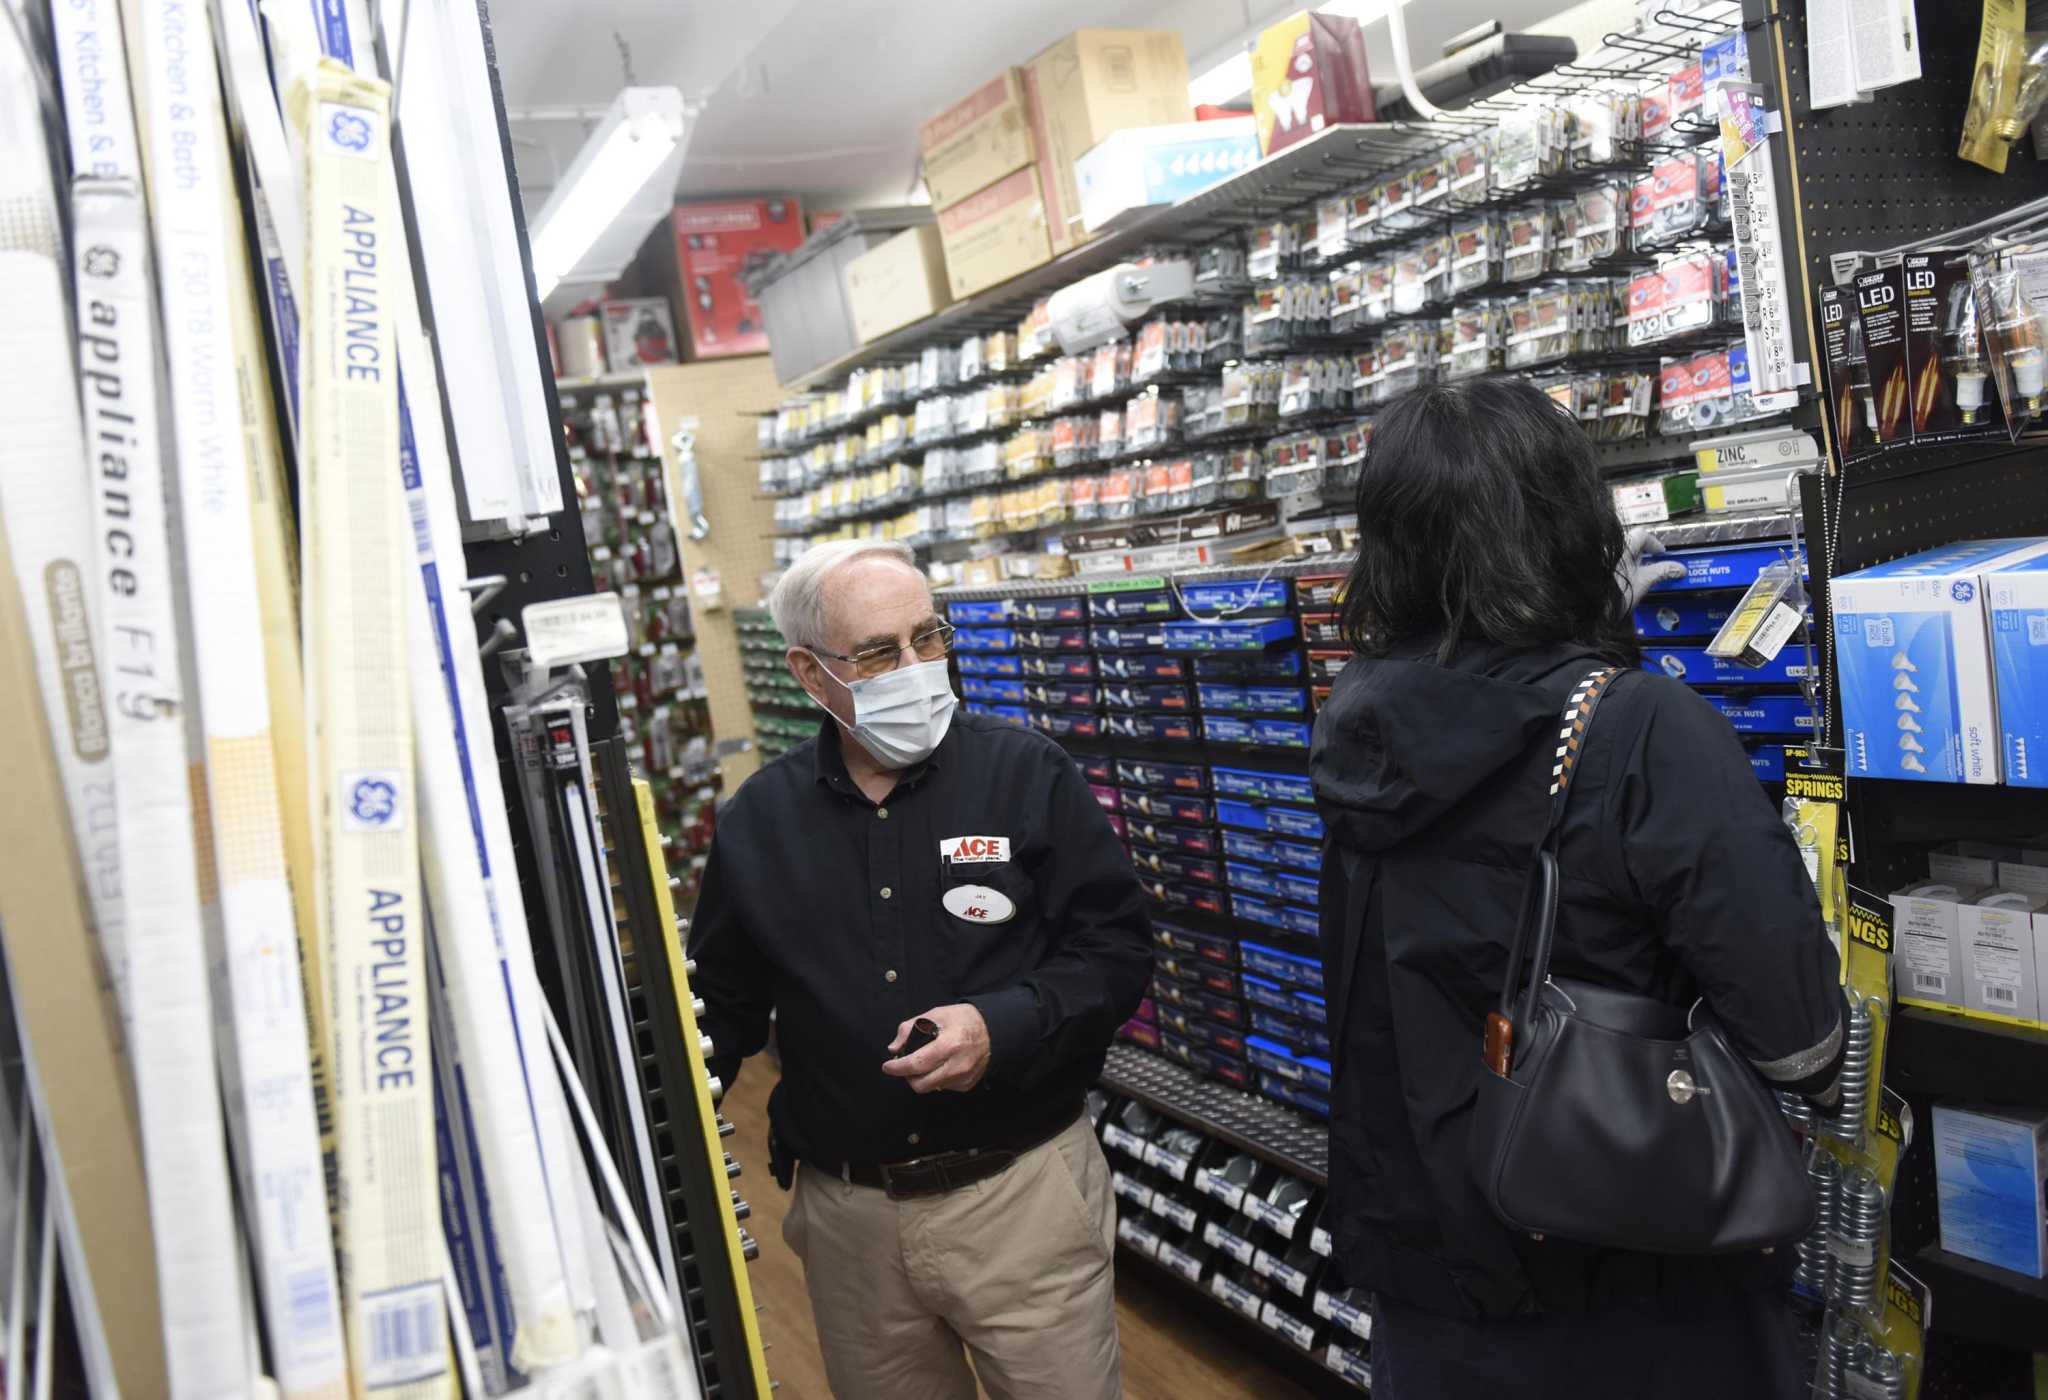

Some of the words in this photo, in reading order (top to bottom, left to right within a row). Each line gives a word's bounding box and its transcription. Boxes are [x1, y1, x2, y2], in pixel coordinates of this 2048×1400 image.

[1906, 271, 1936, 290] LED
[343, 203, 382, 385] APPLIANCE
[1859, 286, 1895, 309] LED
[1824, 303, 1843, 323] LED
[81, 299, 139, 598] appliance
[1716, 446, 1746, 465] ZINC
[1688, 568, 1708, 577] LOCK
[1709, 566, 1731, 575] NUTS
[1968, 726, 1982, 747] soft
[1970, 748, 1983, 777] white
[1786, 778, 1843, 800] SPRINGS
[952, 837, 1000, 857] ACE
[962, 906, 989, 918] ACE
[368, 888, 415, 1092] APPLIANCE
